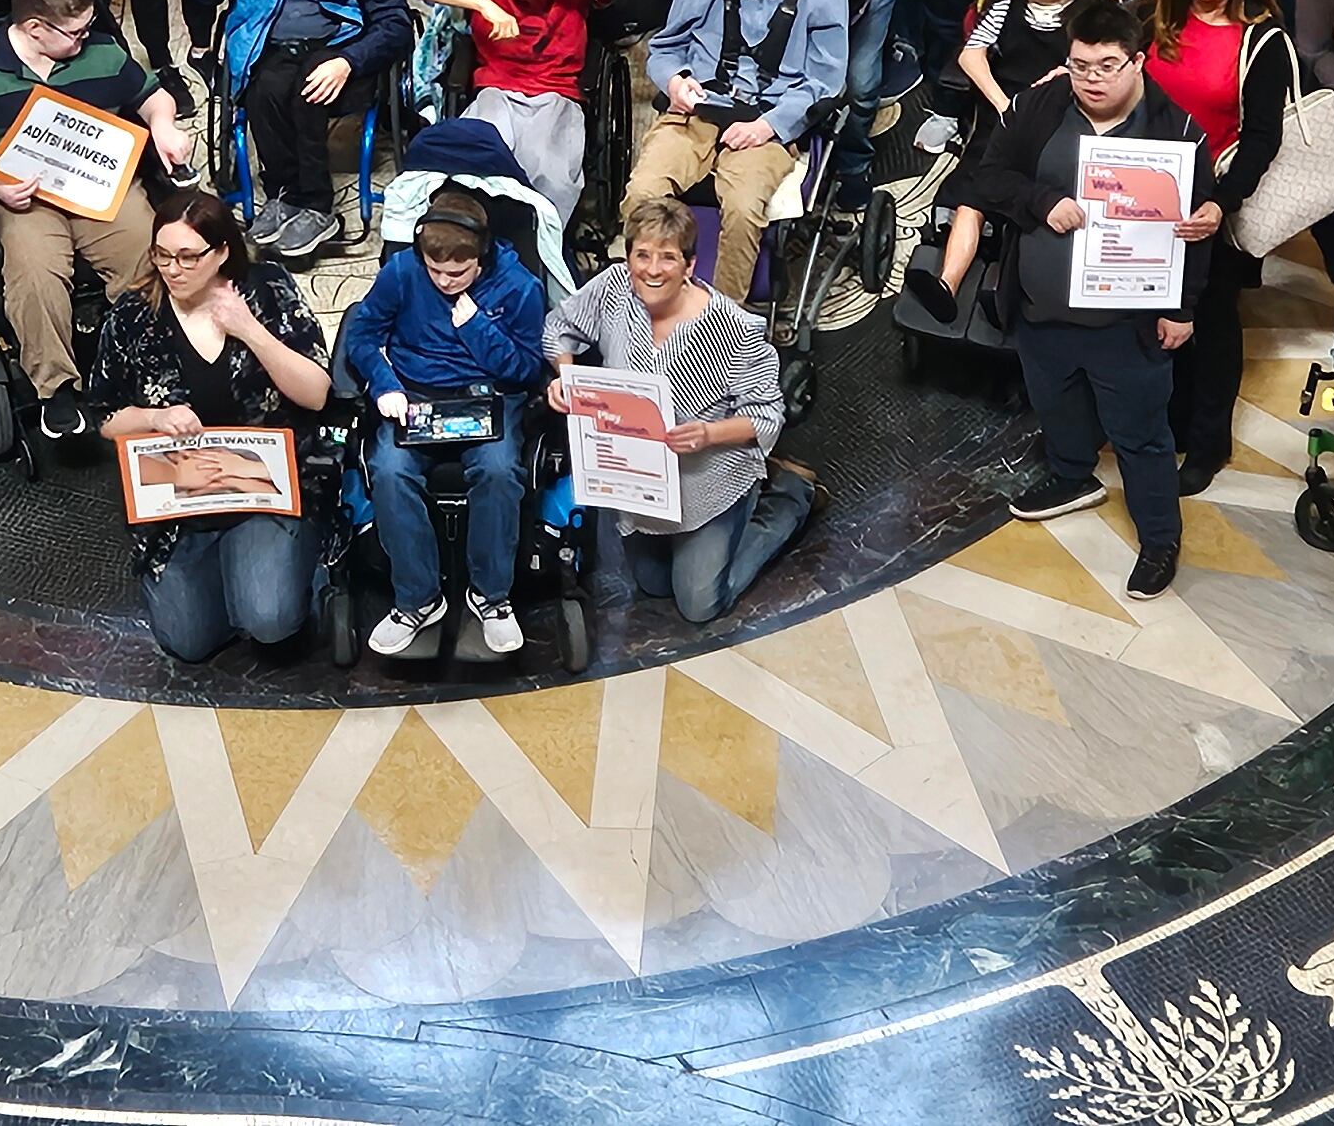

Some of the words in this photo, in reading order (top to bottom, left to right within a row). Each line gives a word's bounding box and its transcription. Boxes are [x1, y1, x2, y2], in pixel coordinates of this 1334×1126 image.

[53, 111, 104, 139] PROTECT
[22, 125, 62, 148] AD/TBI
[62, 139, 118, 171] WAIVERS
[224, 436, 277, 446] WAIVERS
